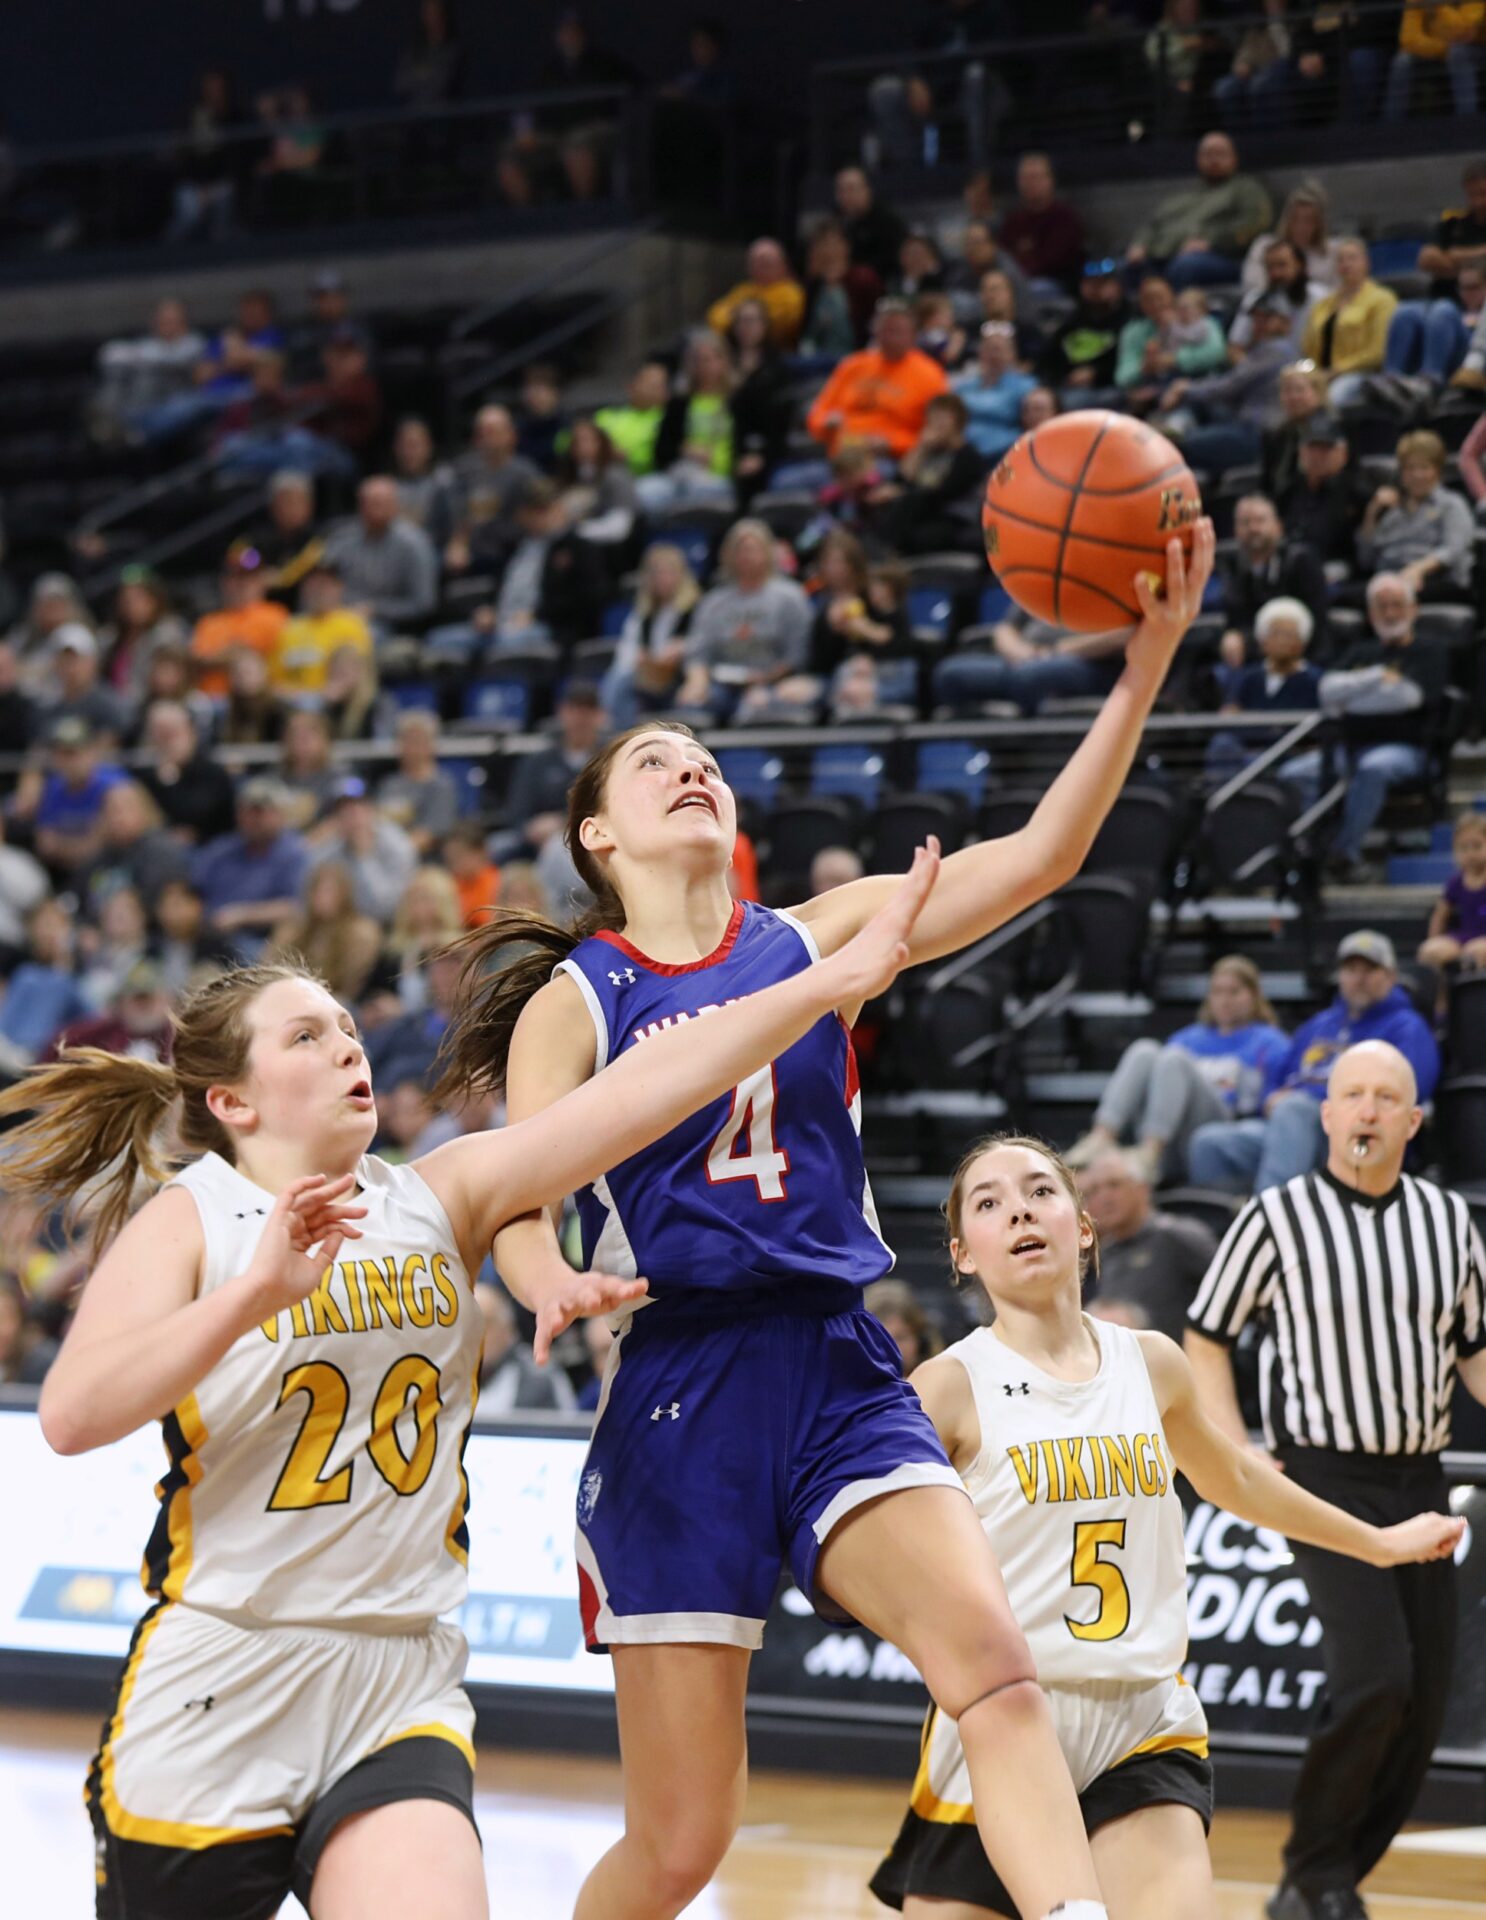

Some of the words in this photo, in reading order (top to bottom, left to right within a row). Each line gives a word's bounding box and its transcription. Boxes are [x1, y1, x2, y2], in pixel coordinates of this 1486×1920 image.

[704, 1062, 790, 1205] 4
[265, 1354, 443, 1512] 20
[1006, 1433, 1168, 1505] VIKINGS
[1063, 1518, 1131, 1642] 5
